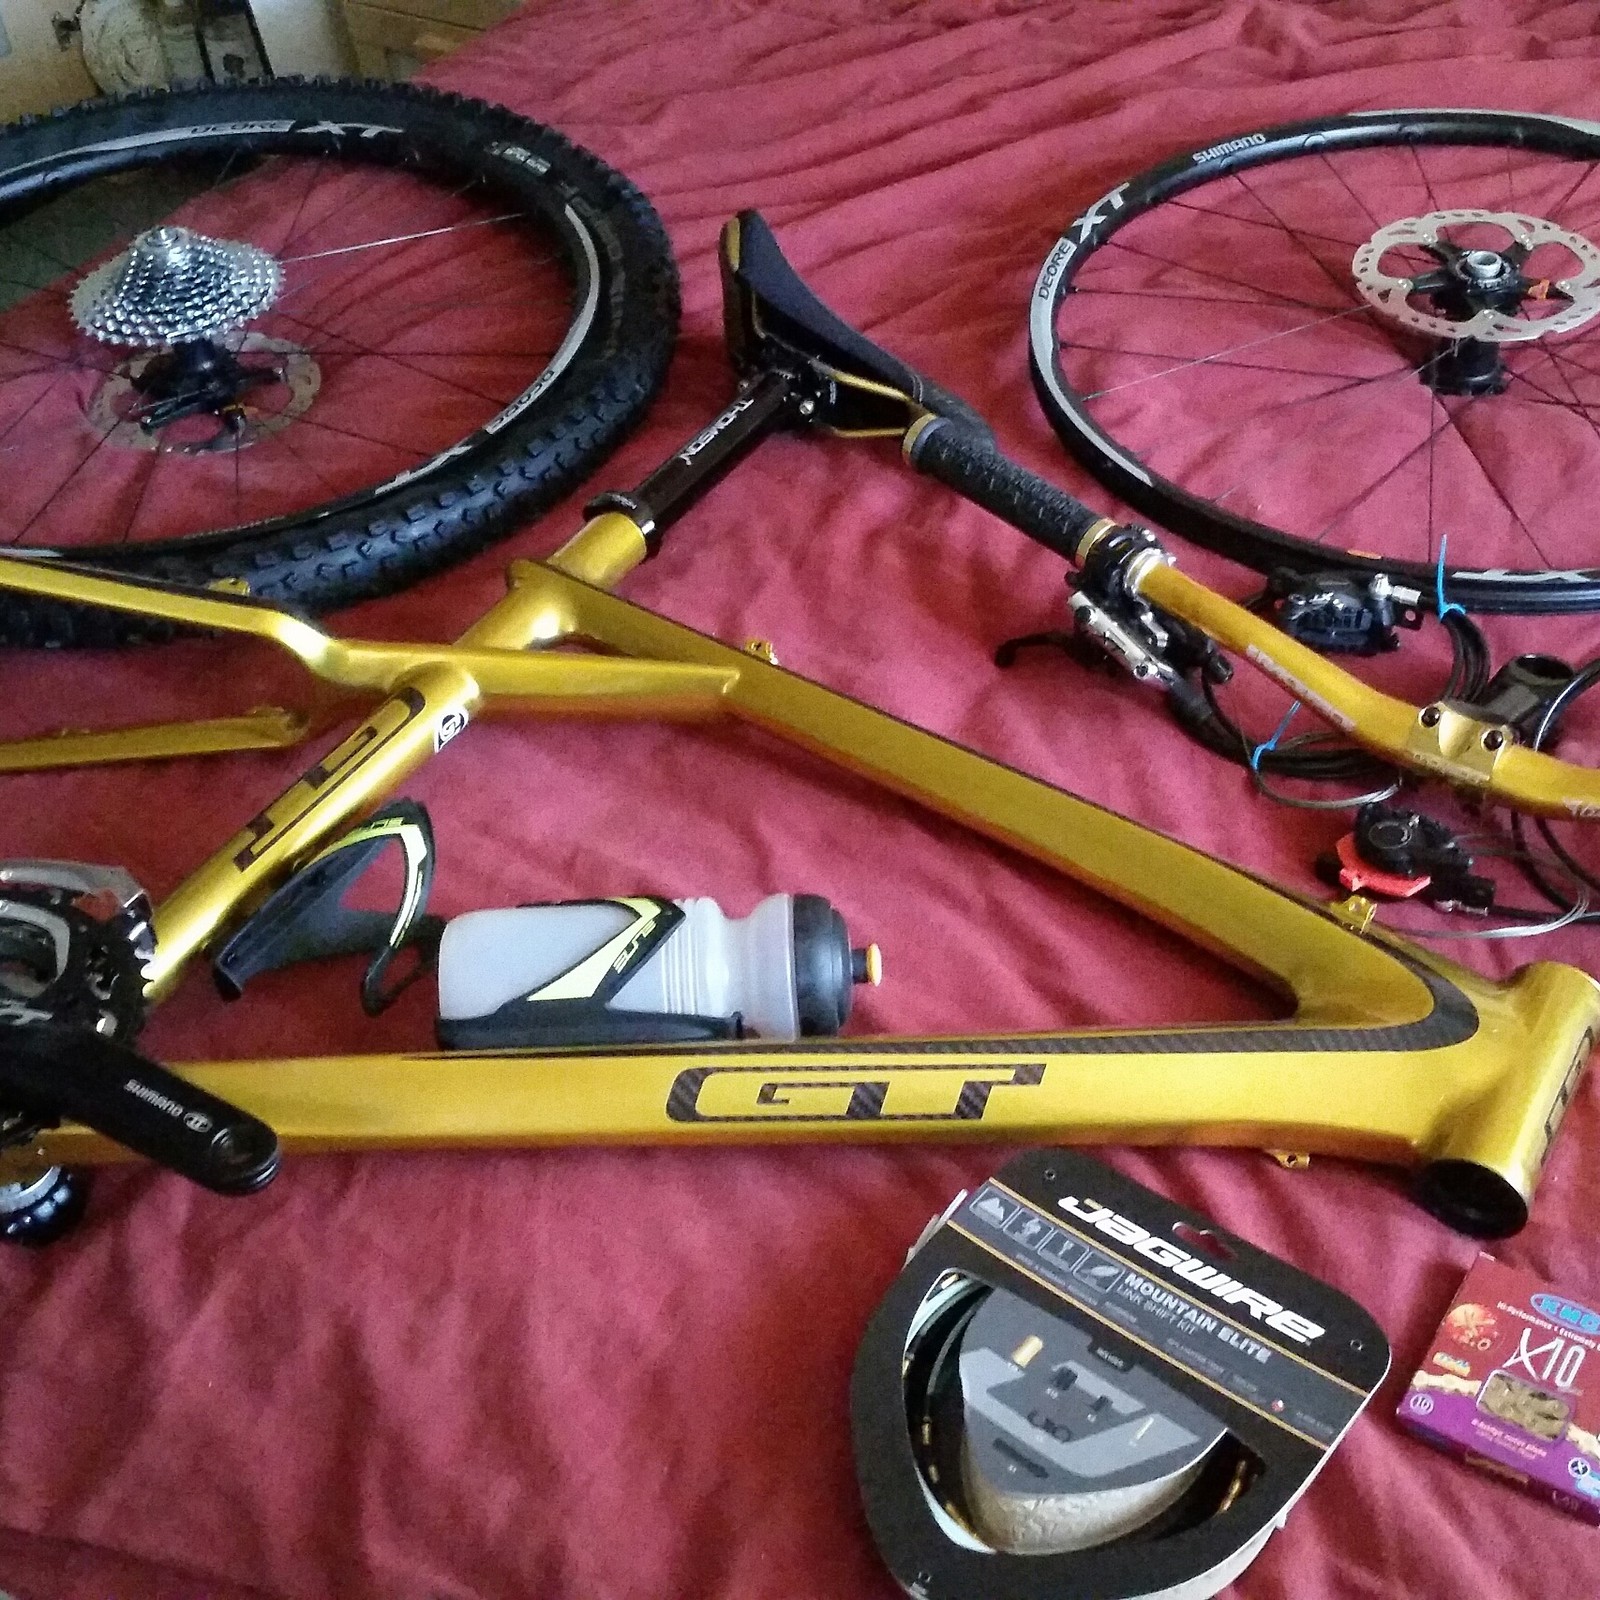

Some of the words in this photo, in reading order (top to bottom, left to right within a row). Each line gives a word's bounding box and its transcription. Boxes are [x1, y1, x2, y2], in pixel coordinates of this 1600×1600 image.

[1192, 133, 1266, 164] SHIMANO
[1038, 242, 1072, 300] DEORE
[1071, 182, 1130, 244] XT
[124, 1079, 184, 1117] SHIMANO
[665, 1063, 1048, 1123] GT
[1057, 1195, 1326, 1345] JAGWIRE
[1116, 1283, 1143, 1306] LINK
[1143, 1300, 1179, 1325] SHIFT
[1176, 1319, 1201, 1335] KIT
[1124, 1272, 1218, 1333] MOUNTAIN
[1217, 1325, 1273, 1364] ELITE
[1501, 1327, 1586, 1388] X10
